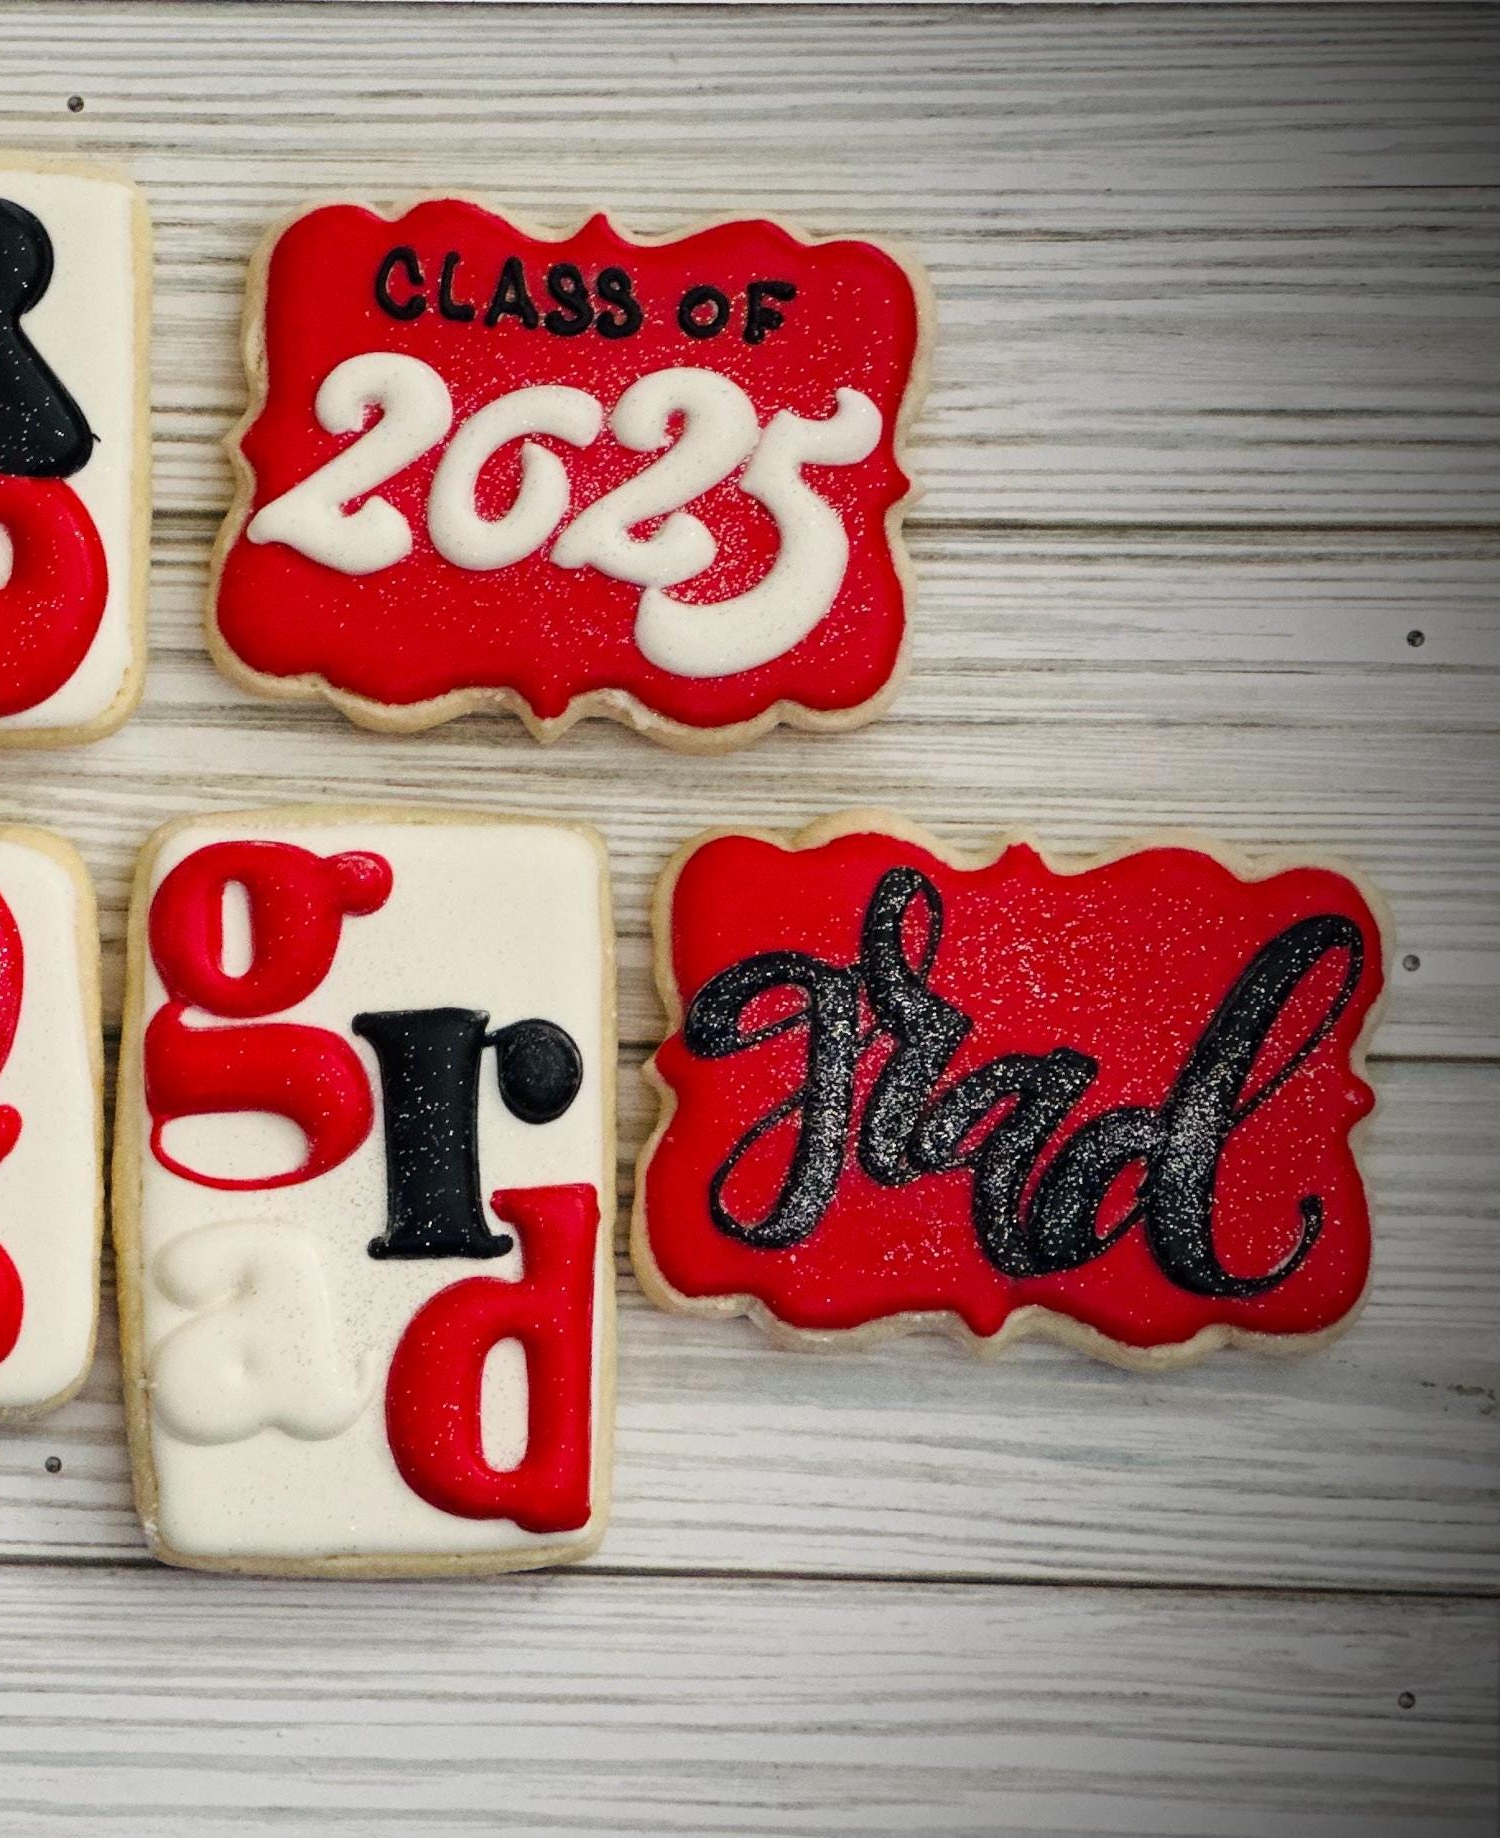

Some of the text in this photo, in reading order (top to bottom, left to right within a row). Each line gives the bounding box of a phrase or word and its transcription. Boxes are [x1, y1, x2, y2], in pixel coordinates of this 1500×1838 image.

[375, 246, 797, 345] CLASS OF
[246, 351, 883, 678] 2025
[683, 866, 1363, 1298] grad
